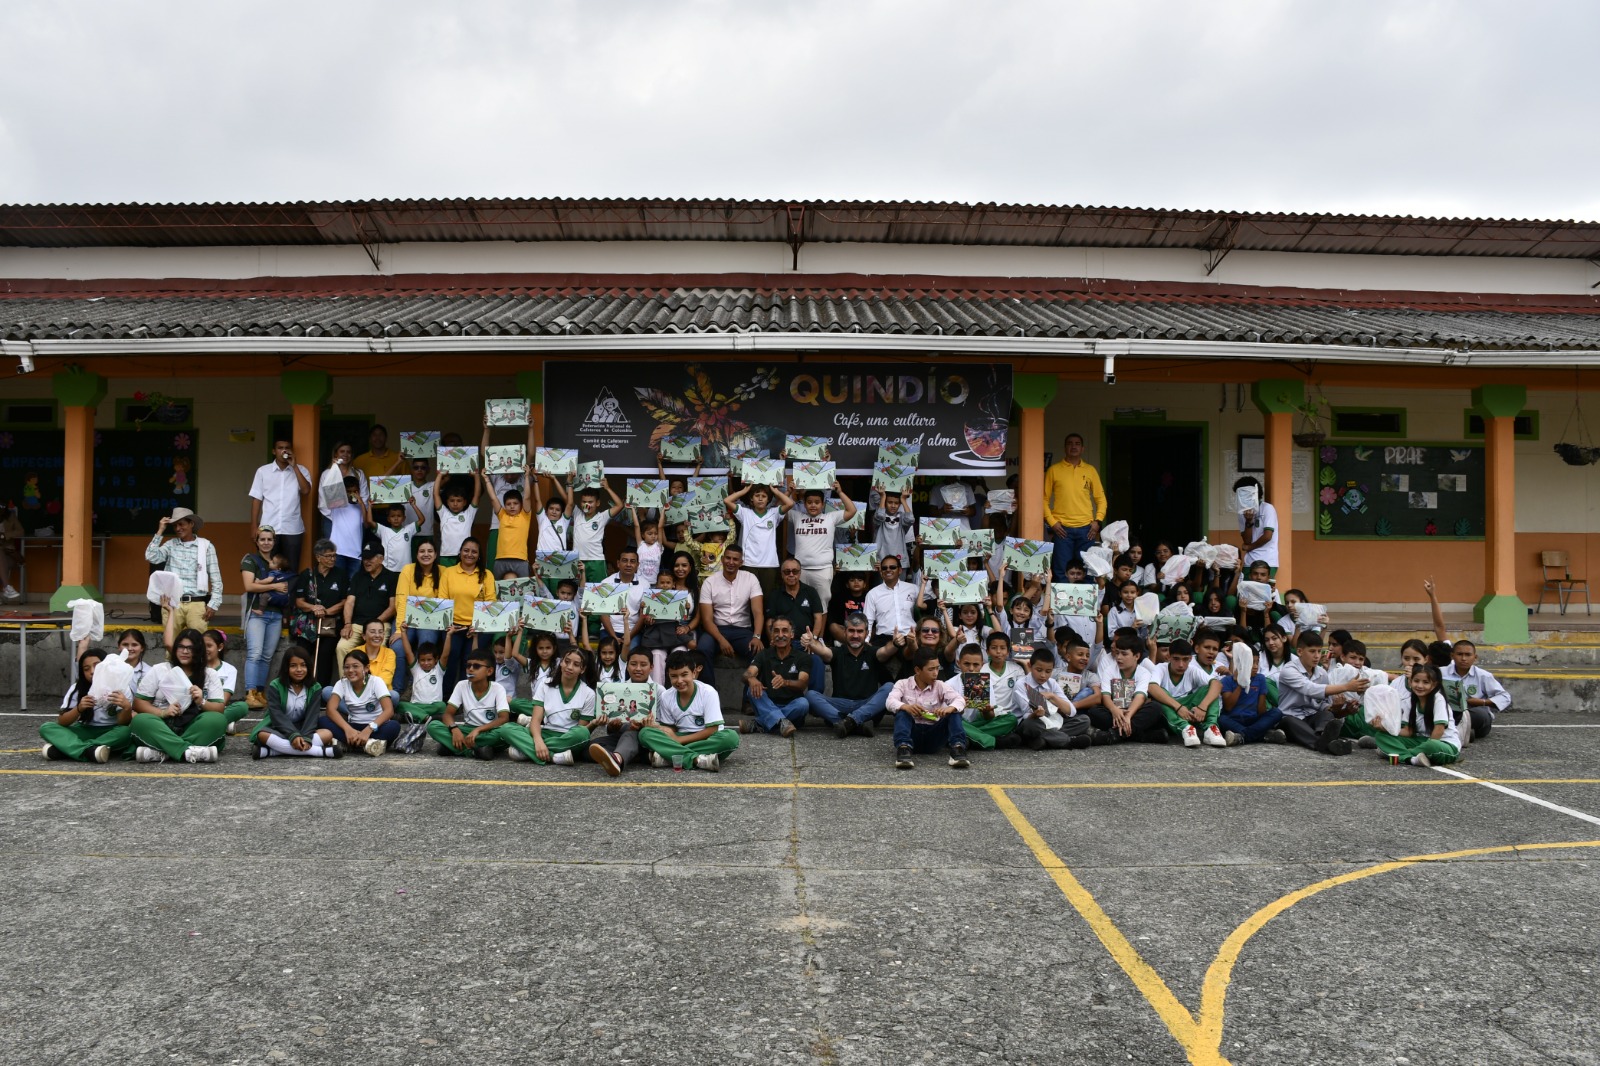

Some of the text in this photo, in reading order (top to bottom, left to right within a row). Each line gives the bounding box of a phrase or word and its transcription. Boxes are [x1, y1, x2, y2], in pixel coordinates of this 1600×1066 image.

[789, 366, 970, 407] QUINDÍO
[833, 411, 937, 429] Café, una cultura
[927, 432, 957, 447] alma
[1383, 446, 1427, 465] PRAE
